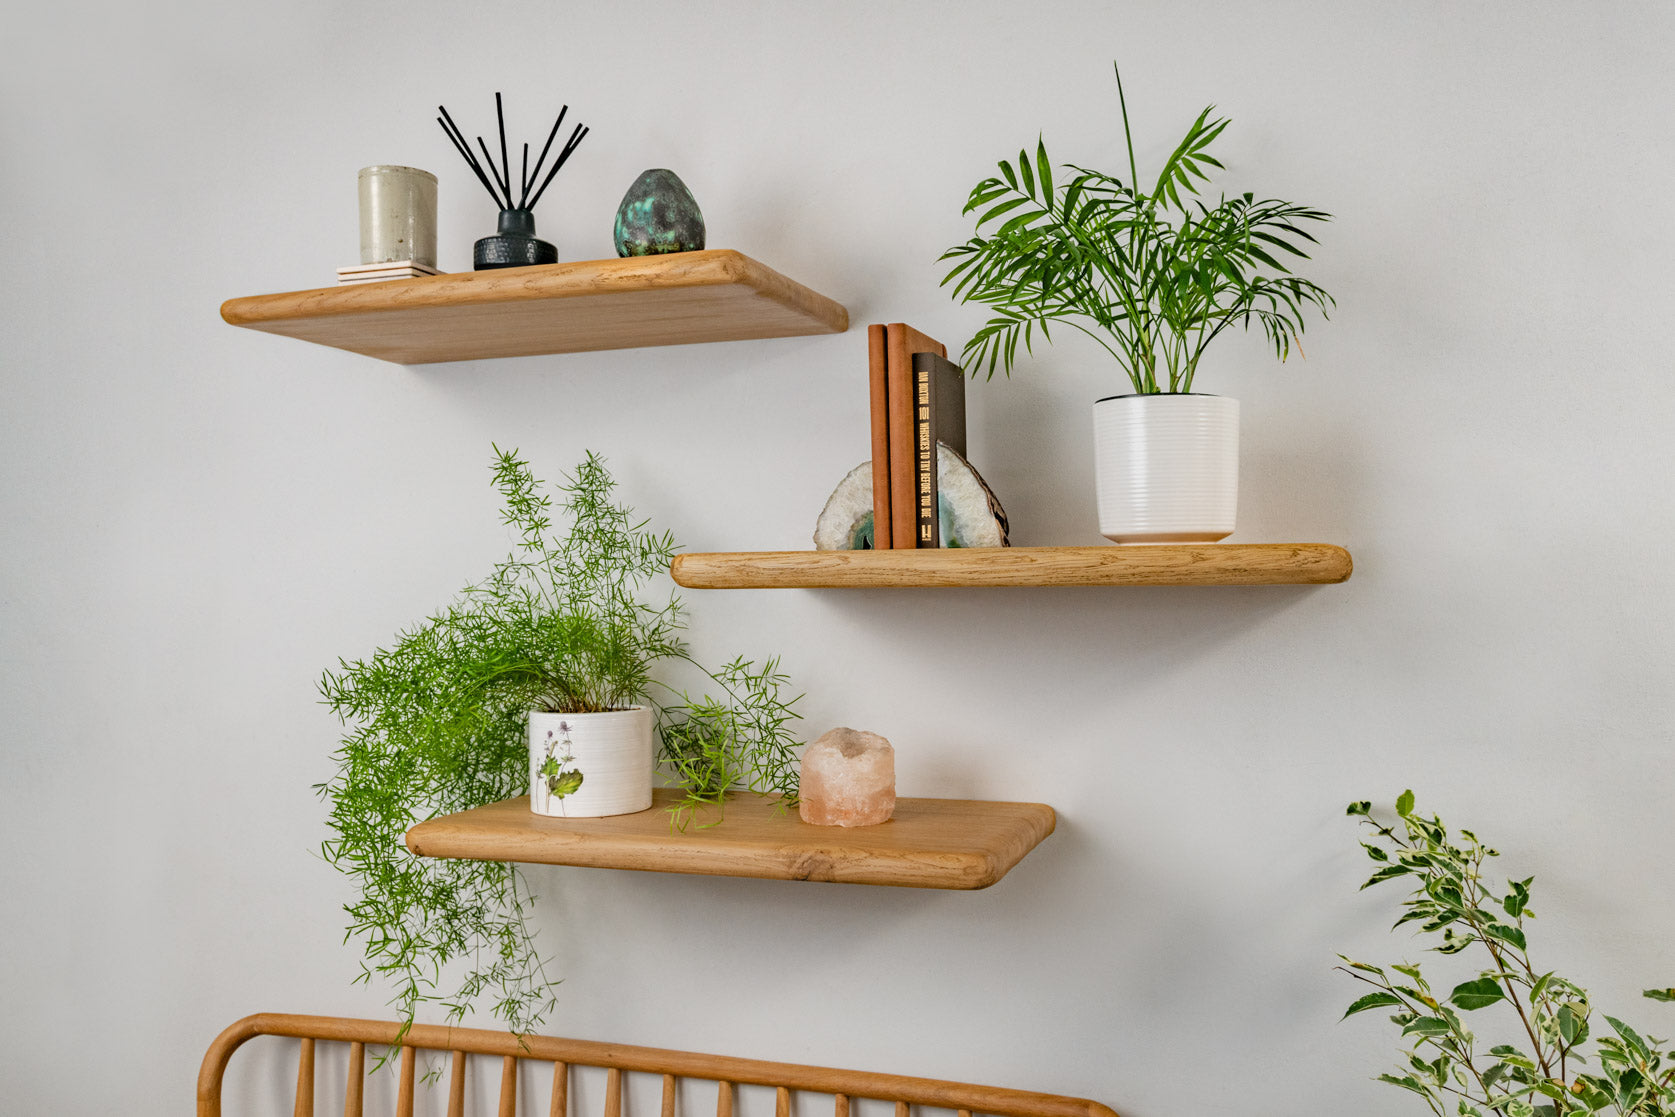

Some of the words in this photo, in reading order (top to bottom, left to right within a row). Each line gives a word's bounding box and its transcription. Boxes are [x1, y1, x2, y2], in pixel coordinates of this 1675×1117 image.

[920, 422, 929, 450] WHISKIES
[921, 451, 930, 460] TO
[921, 460, 930, 471] TRY
[921, 472, 930, 493] BEFORE
[921, 495, 930, 506] YOU
[922, 507, 931, 518] DIE
